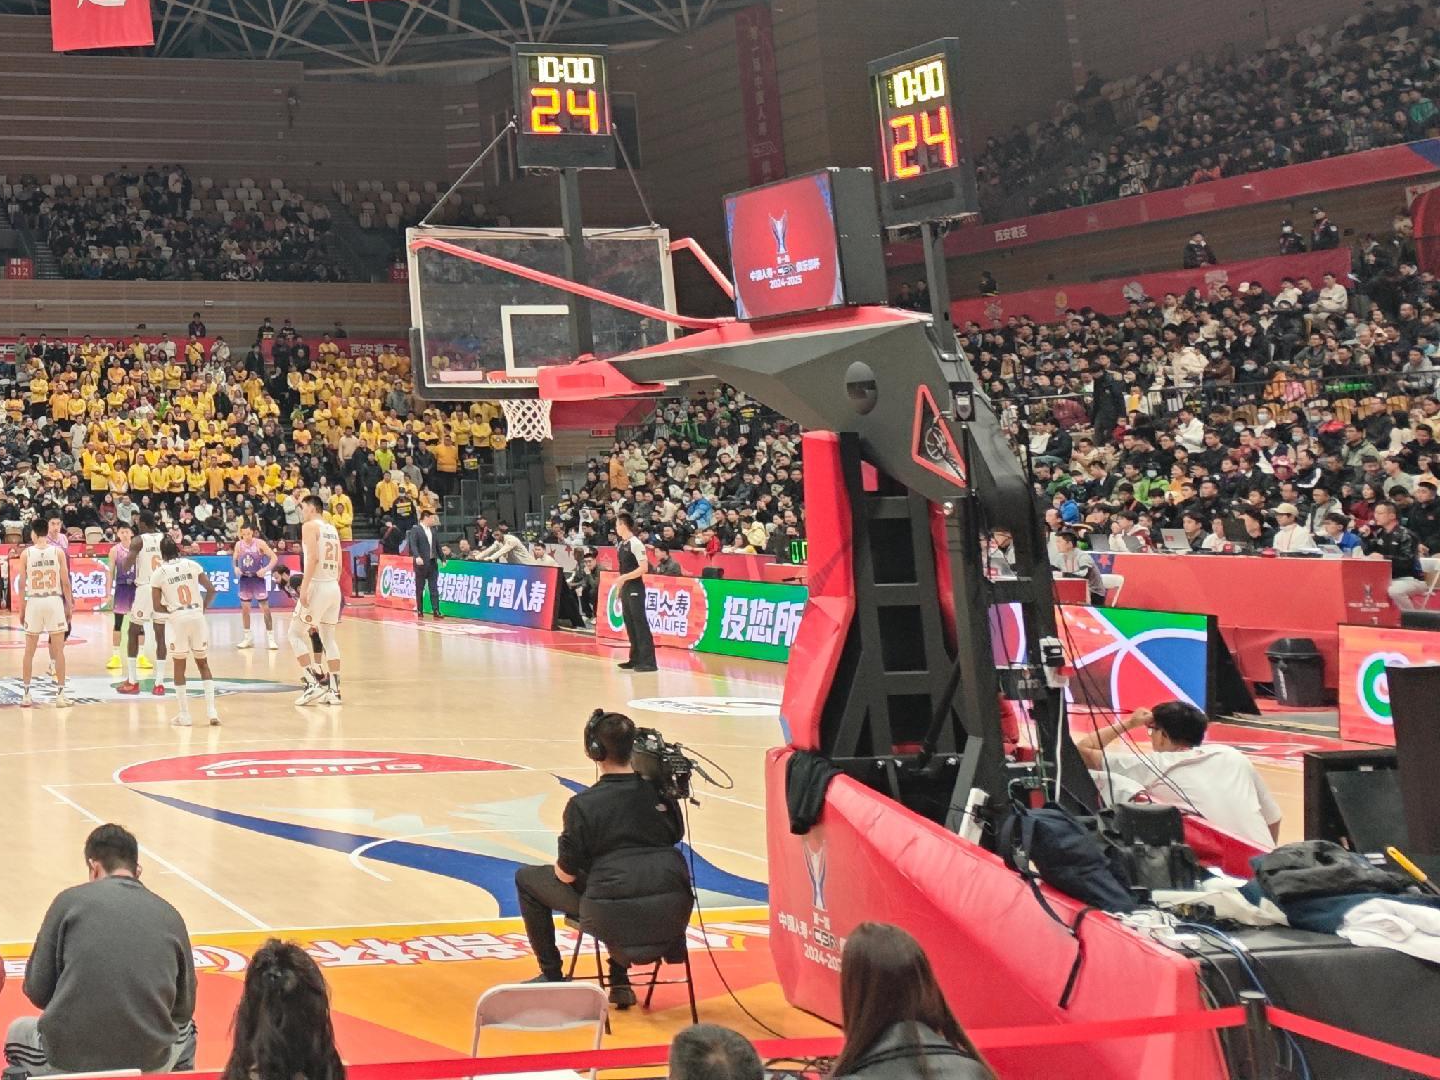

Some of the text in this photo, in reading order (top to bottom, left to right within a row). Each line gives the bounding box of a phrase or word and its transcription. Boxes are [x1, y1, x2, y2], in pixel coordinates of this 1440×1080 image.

[537, 56, 595, 85] 10:00
[893, 60, 946, 108] 10:00
[530, 87, 599, 134] 24
[889, 106, 954, 179] 24
[32, 570, 57, 589] 23
[177, 584, 192, 605] 0
[486, 576, 547, 613] 中国人寿
[664, 618, 687, 633] LIFE
[206, 763, 423, 777] LI-NING
